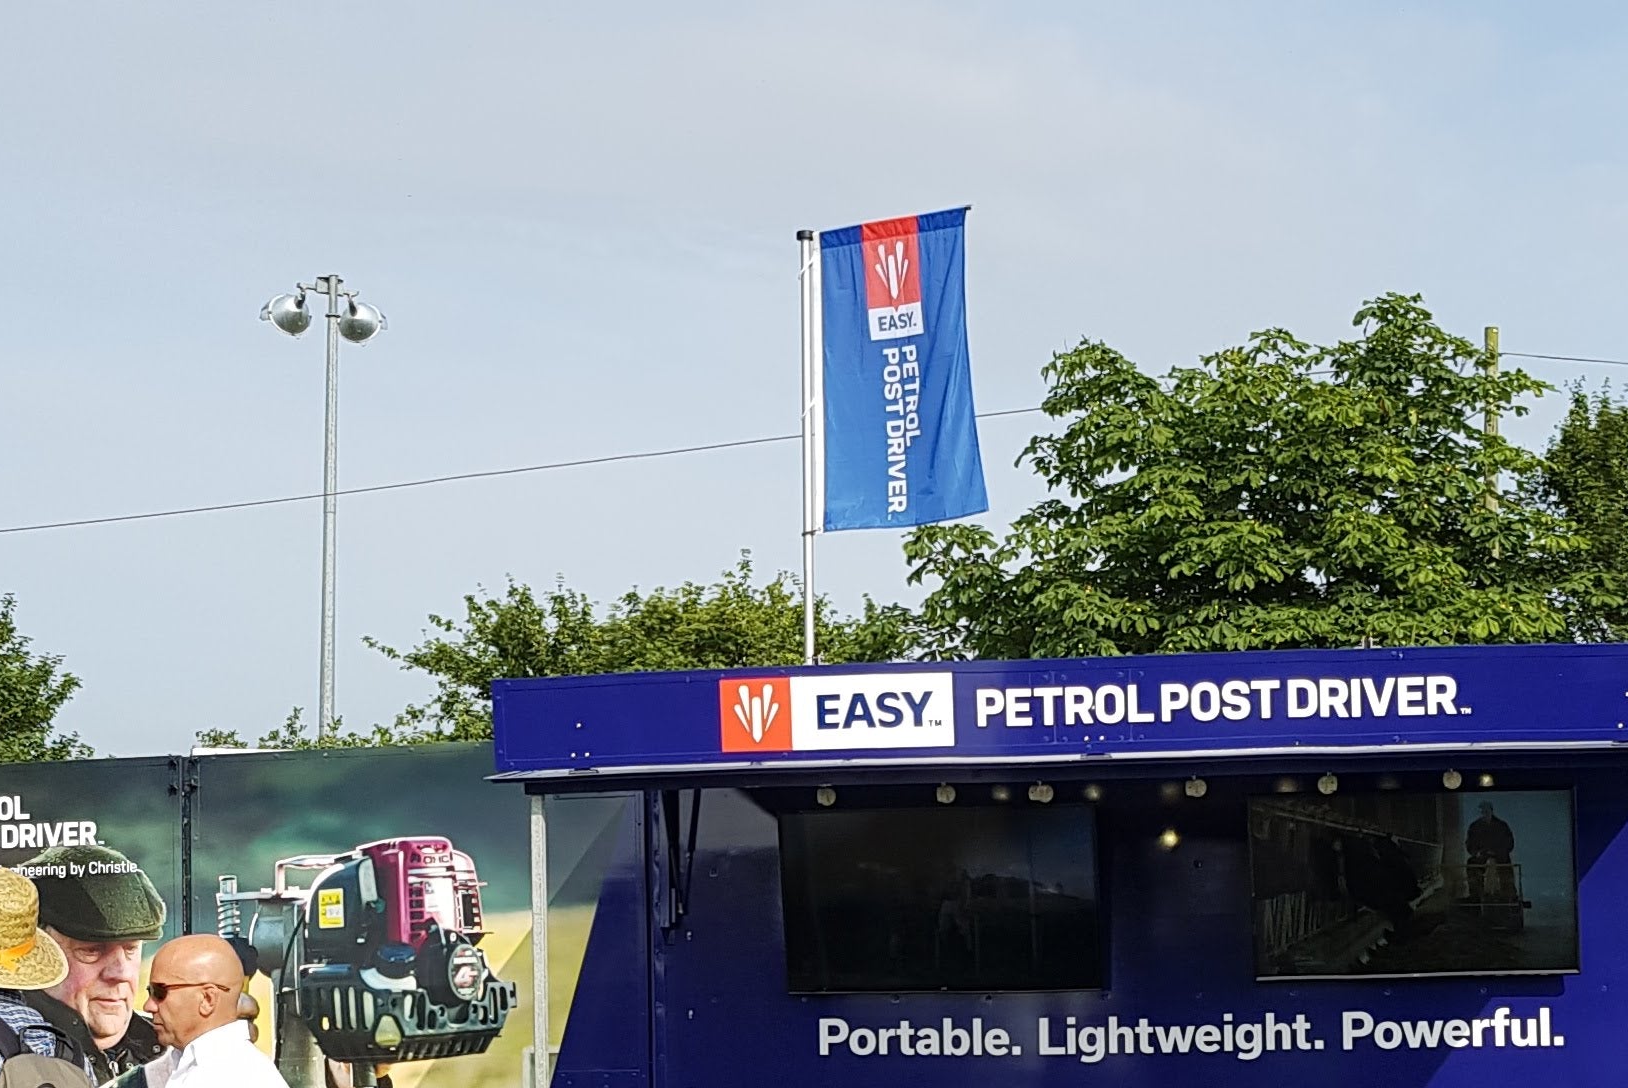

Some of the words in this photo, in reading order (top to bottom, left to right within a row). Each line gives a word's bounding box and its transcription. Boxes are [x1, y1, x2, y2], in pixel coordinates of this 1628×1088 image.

[877, 311, 915, 333] EASY
[883, 347, 904, 416] POST
[902, 344, 922, 447] PETROL
[886, 417, 908, 514] DRIVER
[817, 691, 933, 729] EASY
[976, 684, 1155, 727] PETROL
[1161, 680, 1280, 722] POST
[1287, 676, 1458, 718] DRIVER
[1, 821, 97, 849] DRIVER
[70, 863, 85, 877] by
[819, 1017, 1022, 1057] Portable.
[1037, 1013, 1325, 1063] Lightweight.
[1342, 1008, 1565, 1052] Powerful.
